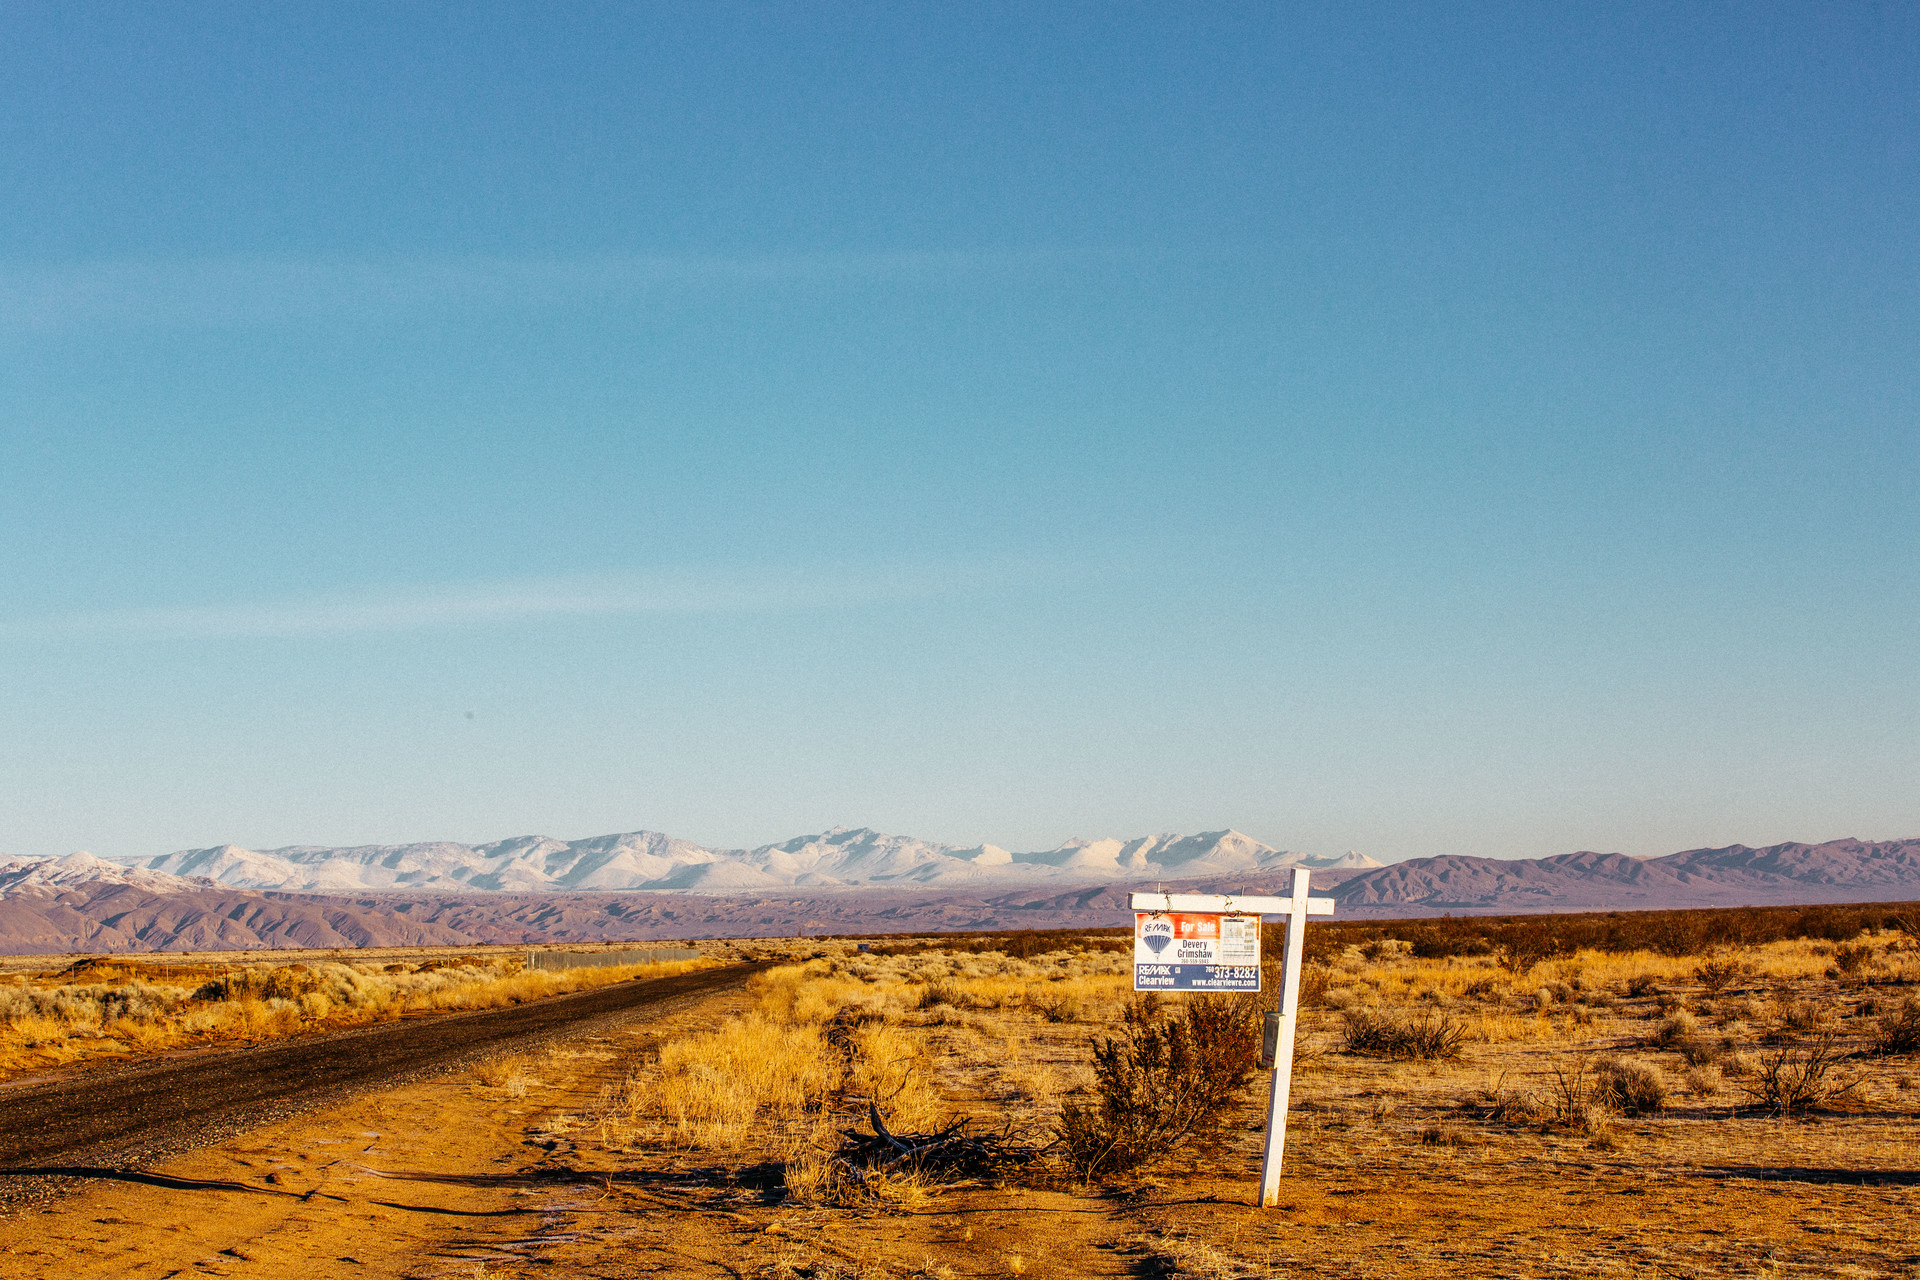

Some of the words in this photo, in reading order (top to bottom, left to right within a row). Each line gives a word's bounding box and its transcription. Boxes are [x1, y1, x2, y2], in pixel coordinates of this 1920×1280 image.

[1145, 923, 1170, 933] REMAX
[1181, 922, 1194, 932] For
[1197, 922, 1216, 932] Sale
[1182, 940, 1207, 950] Devery
[1177, 949, 1213, 958] Grimshaw
[1138, 965, 1171, 975] RE/MAX
[1214, 966, 1256, 979] 373-8282
[1138, 976, 1175, 985] Clearview
[1192, 978, 1257, 987] www.clearviewre.com
